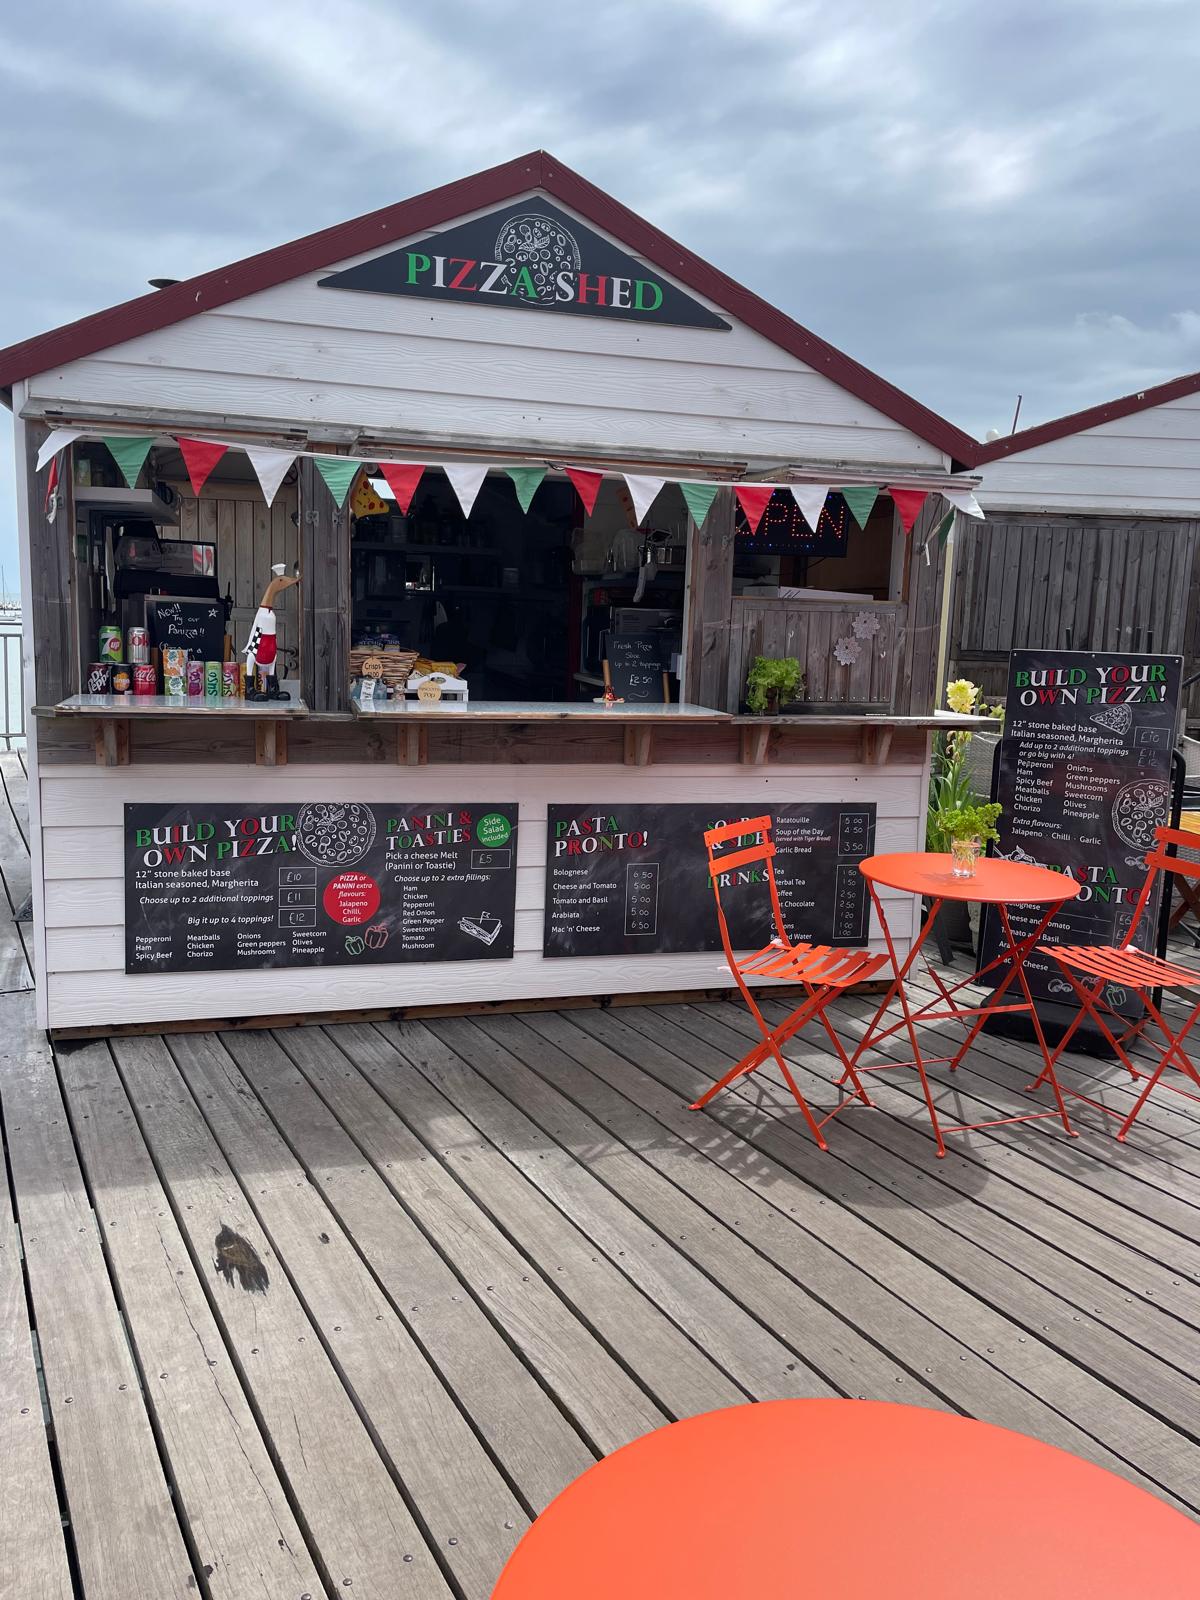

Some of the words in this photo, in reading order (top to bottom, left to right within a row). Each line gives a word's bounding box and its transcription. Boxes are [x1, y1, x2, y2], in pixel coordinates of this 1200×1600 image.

[405, 252, 539, 299] PIZZA
[555, 272, 663, 311] SHED
[364, 662, 381, 671] Crisps
[1015, 669, 1087, 688] BUILD
[1096, 665, 1167, 684] YOUR
[1020, 689, 1077, 706] OWN
[1086, 685, 1167, 704] PIZZA!
[1052, 723, 1076, 732] baked
[1078, 725, 1097, 733] base
[1011, 729, 1035, 739] Italian
[1037, 732, 1076, 743] seasoned,
[1079, 735, 1123, 746] Margherita
[1020, 741, 1030, 749] Add
[1032, 743, 1043, 751] up
[1059, 744, 1095, 753] additional
[1097, 747, 1129, 756] toppings
[1038, 751, 1048, 759] big
[1018, 760, 1053, 770] Pepperoni
[1067, 764, 1093, 773] Onions
[1016, 777, 1035, 787] Spicy
[1037, 779, 1053, 787] Beef
[1066, 773, 1088, 781] Green
[1090, 776, 1120, 785] peppers
[1015, 786, 1049, 795] Meatballs
[1065, 782, 1108, 792] Mushrooms
[1015, 795, 1042, 803] Chicken
[1065, 791, 1103, 801] Sweetcorn
[1014, 804, 1040, 812] Chorizo
[1064, 800, 1086, 809] Olives
[1063, 809, 1099, 820] Pineapple
[387, 813, 452, 833] PANINI
[459, 811, 472, 825] &
[483, 817, 501, 826] Side
[555, 816, 618, 837] PASTA
[1013, 817, 1030, 826] Extra
[1032, 819, 1063, 829] flavours:
[136, 823, 215, 848] BUILD
[224, 815, 296, 837] YOUR
[483, 824, 504, 834] Salad
[386, 829, 471, 850] TOASTIES
[1012, 828, 1043, 838] Jalapeno
[1080, 836, 1101, 845] Garlic
[555, 831, 648, 857] PRONTO!
[144, 844, 207, 867] OWN
[216, 834, 297, 859] PIZZA!
[386, 852, 402, 860] Pick
[411, 852, 438, 860] cheese
[386, 862, 413, 870] (Panini
[425, 861, 456, 870] Toastie)
[136, 870, 151, 878] 12"
[154, 870, 179, 878] stone
[211, 869, 230, 877] base
[287, 872, 301, 883] £10
[465, 873, 491, 882] fillings:
[554, 869, 588, 877] Bolognese
[136, 881, 163, 889] Italian
[166, 880, 210, 889] seasoned,
[212, 879, 259, 890] Margherita
[140, 896, 168, 904] Choose
[170, 897, 180, 905] up
[199, 894, 238, 902] additional
[239, 895, 273, 904] toppings
[403, 901, 434, 909] Pepperoni
[188, 916, 200, 925] Big
[209, 917, 219, 925] up
[221, 916, 229, 924] to
[238, 915, 273, 925] toppings!
[422, 917, 445, 925] Pepper
[1048, 922, 1070, 930] omato
[136, 936, 171, 944] Pepperoni
[237, 932, 261, 940] Onions
[1043, 934, 1059, 942] Basil
[259, 940, 286, 949] peppers
[293, 946, 325, 954] Pineapple
[136, 952, 155, 960] Spicy
[1023, 960, 1048, 971] Cheese
